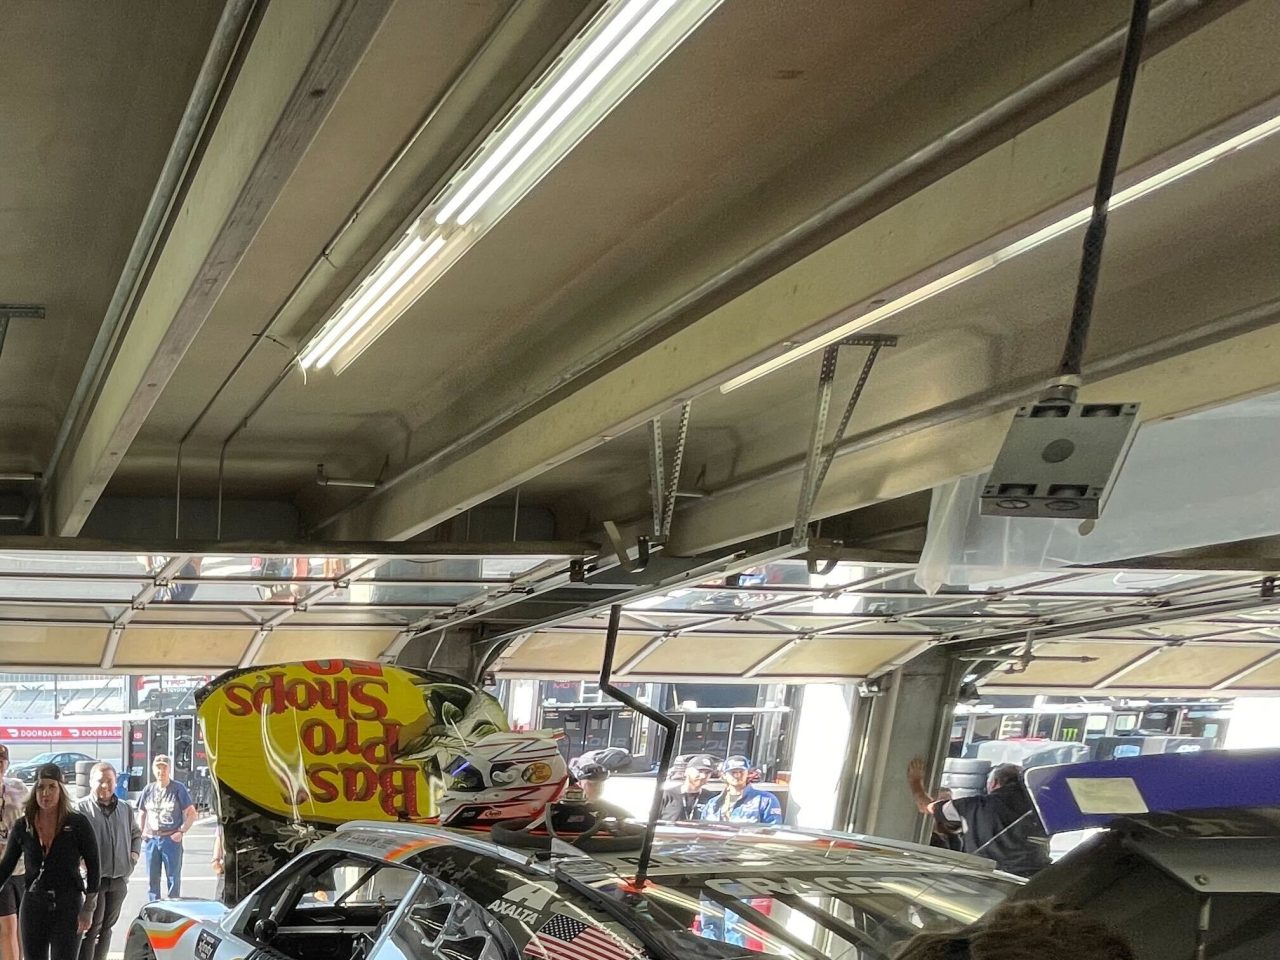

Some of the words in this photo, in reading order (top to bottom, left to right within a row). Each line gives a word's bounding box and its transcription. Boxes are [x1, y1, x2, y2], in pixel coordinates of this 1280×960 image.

[224, 672, 390, 720] Shops
[20, 729, 62, 738] DOORDASH
[81, 729, 122, 738] DOORDASH
[300, 717, 405, 766] Pro
[704, 876, 983, 897] GRAGSON
[487, 899, 540, 925] AXALTA
